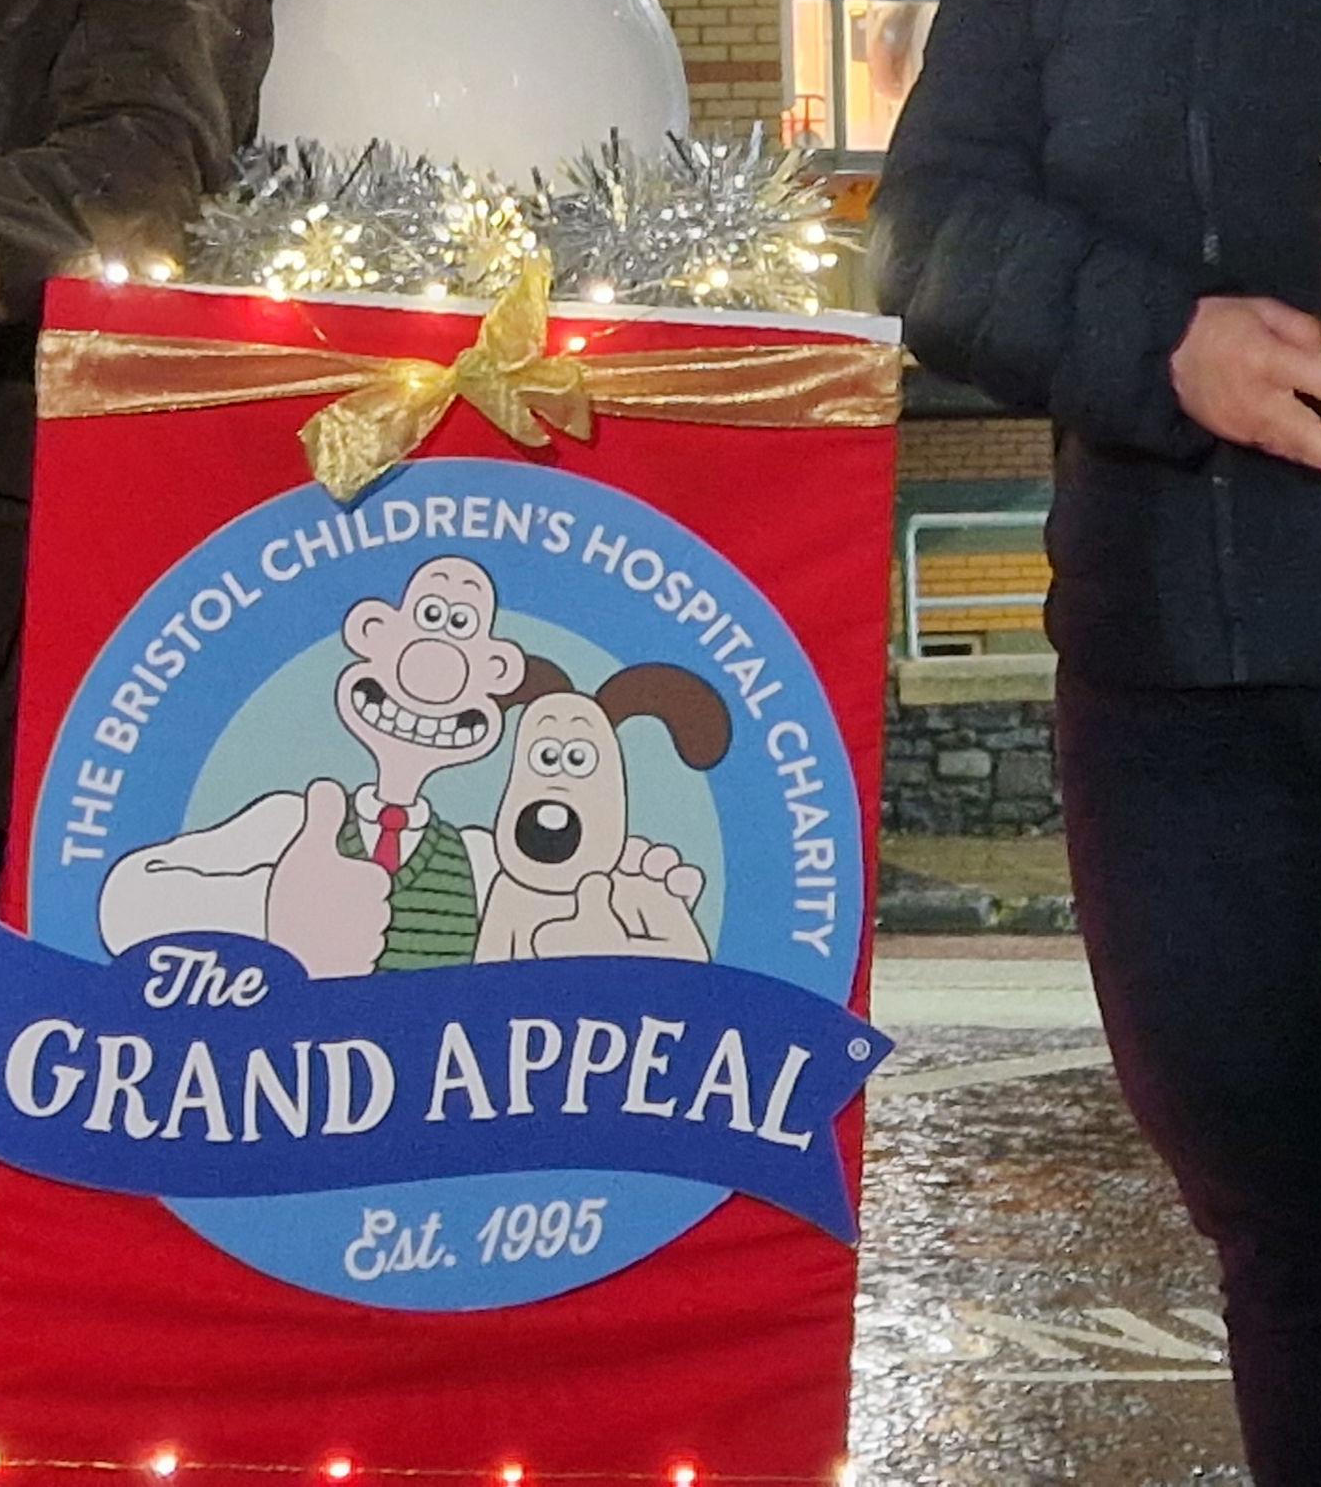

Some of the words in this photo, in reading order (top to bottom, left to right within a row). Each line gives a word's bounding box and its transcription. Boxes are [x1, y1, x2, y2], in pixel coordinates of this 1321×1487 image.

[61, 759, 124, 866] THE
[94, 571, 263, 754] BRISTOL
[260, 496, 575, 581] CHILDREN'S
[581, 525, 782, 720] HOSPITAL
[767, 720, 836, 958] CHARITY
[143, 944, 270, 1008] The
[5, 1018, 396, 1142] GRAND
[423, 1014, 814, 1152] APPEAL
[344, 1207, 457, 1281] Est.
[476, 1197, 609, 1264] 1995
